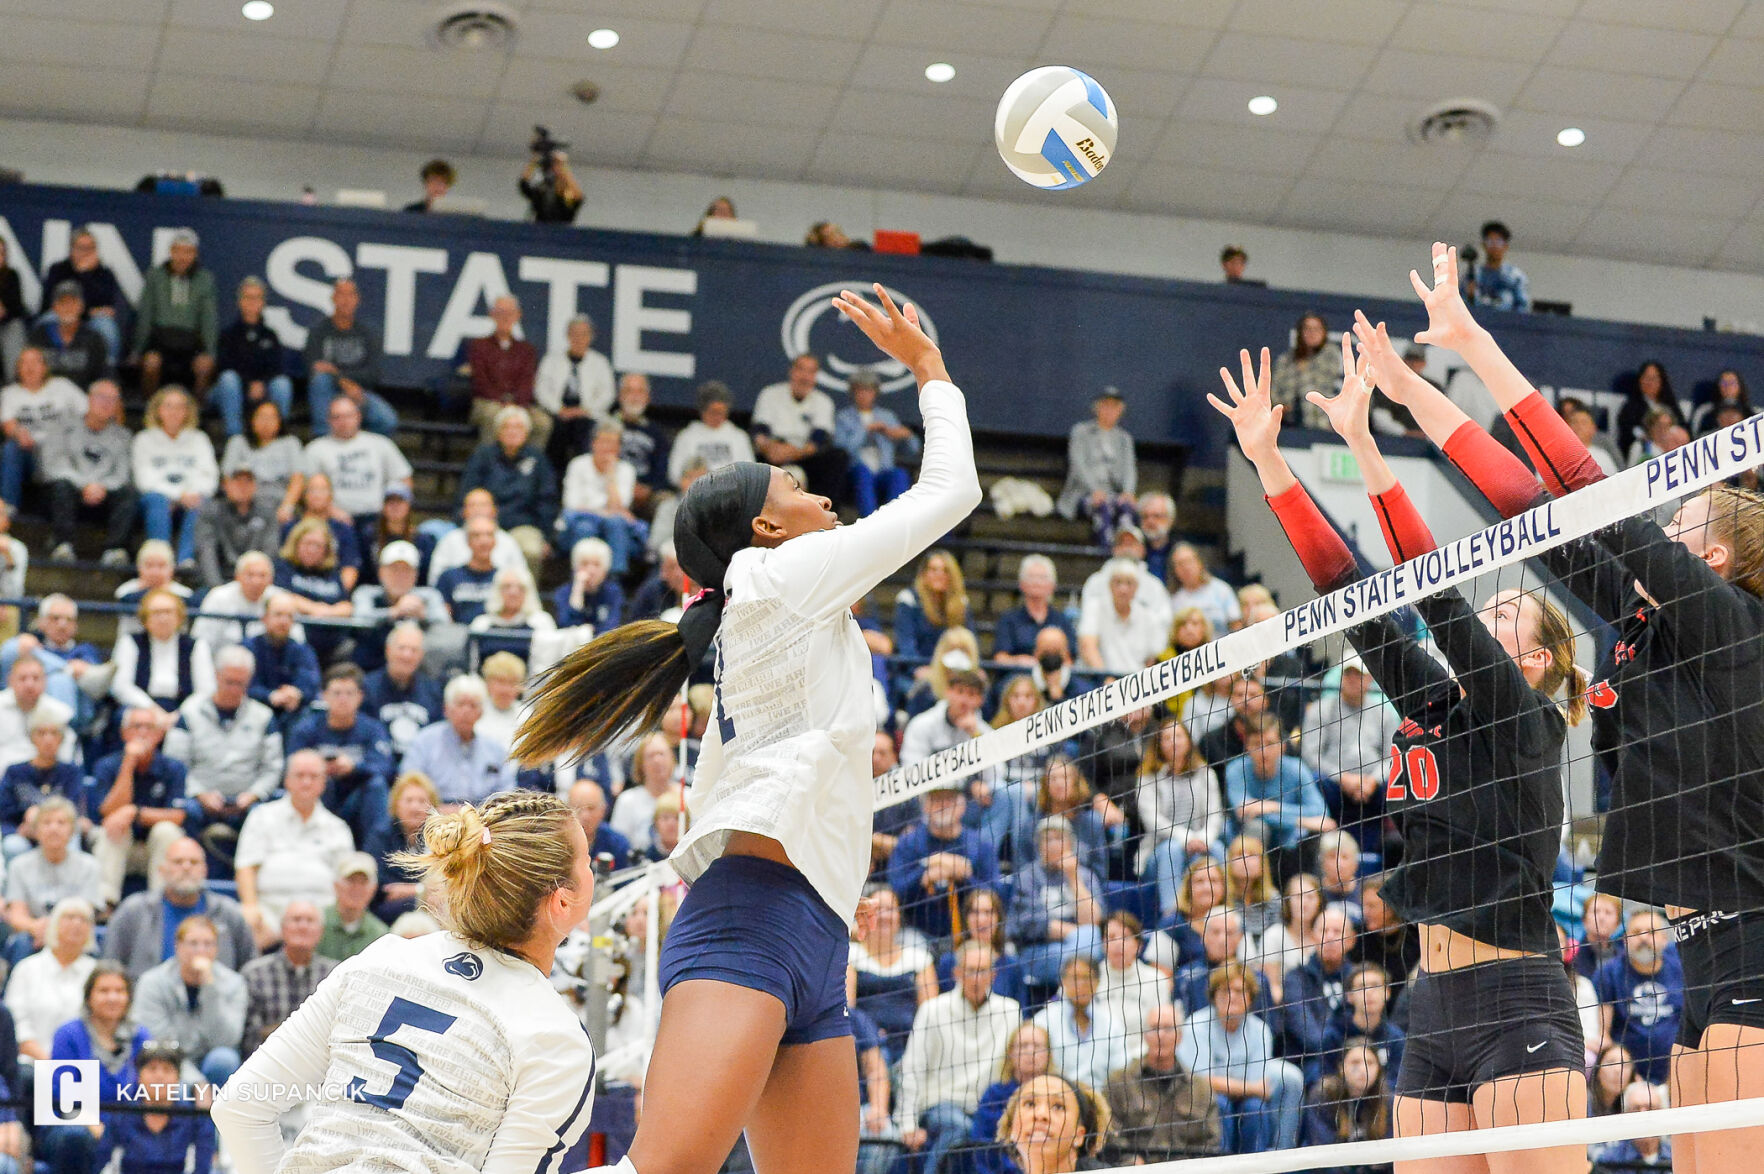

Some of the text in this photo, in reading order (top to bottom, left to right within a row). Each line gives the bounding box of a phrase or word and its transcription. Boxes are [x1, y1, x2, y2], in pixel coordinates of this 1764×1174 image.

[1075, 138, 1105, 172] Baden
[266, 236, 697, 379] STATE
[1646, 433, 1719, 498] PENN
[1285, 502, 1561, 642] PENN STATE VOLLEYBALL
[1026, 640, 1226, 743] PENN STATE VOLLEYBALL
[905, 740, 982, 790] VOLLEYBALL
[1386, 744, 1440, 801] 20
[347, 995, 458, 1111] 5
